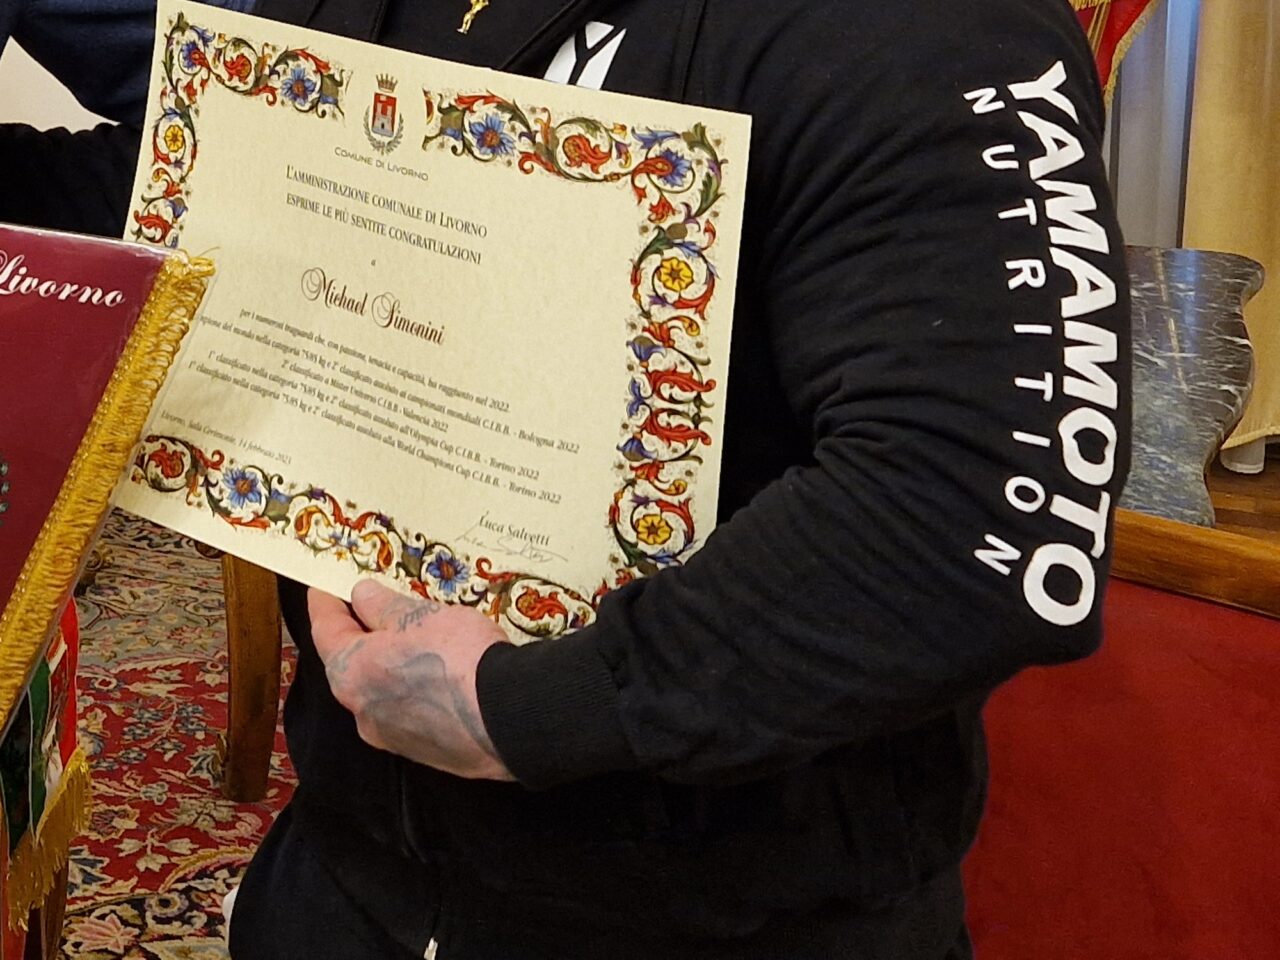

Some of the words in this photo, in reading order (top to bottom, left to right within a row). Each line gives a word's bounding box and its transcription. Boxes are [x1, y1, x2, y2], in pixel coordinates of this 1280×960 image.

[334, 146, 373, 166] COMUNE
[375, 159, 385, 169] DI
[387, 162, 429, 182] LIVORNO
[286, 164, 370, 204] L'AMMINISTRAZIONE
[372, 194, 422, 220] COMUNALE
[425, 209, 436, 225] DI
[439, 211, 488, 238] LIVORNO
[286, 193, 320, 214] ESPRIME
[322, 204, 332, 218] LE
[334, 207, 348, 224] PIÙ
[351, 214, 387, 236] SENTITE
[388, 226, 482, 265] CONGRATULAZIONI
[301, 267, 368, 317] Michael
[371, 291, 445, 345] Simonini
[963, 86, 1053, 576] NUTRITION
[1007, 60, 1118, 626] YAMAMOTO
[427, 378, 437, 389] ha
[438, 382, 474, 402] raggiunto
[475, 394, 488, 407] nel
[431, 418, 449, 433] 2022
[518, 429, 555, 447] Bologna
[556, 438, 580, 454] 2022
[397, 440, 416, 456] World
[416, 449, 455, 471] Champions
[455, 464, 471, 480] Cup
[509, 481, 537, 498] Torino
[538, 489, 562, 504] 2022
[439, 439, 454, 453] Cup
[489, 457, 516, 473] Torino
[517, 465, 540, 481] 2022
[479, 511, 504, 533] Luca
[507, 524, 550, 546] Salvetti
